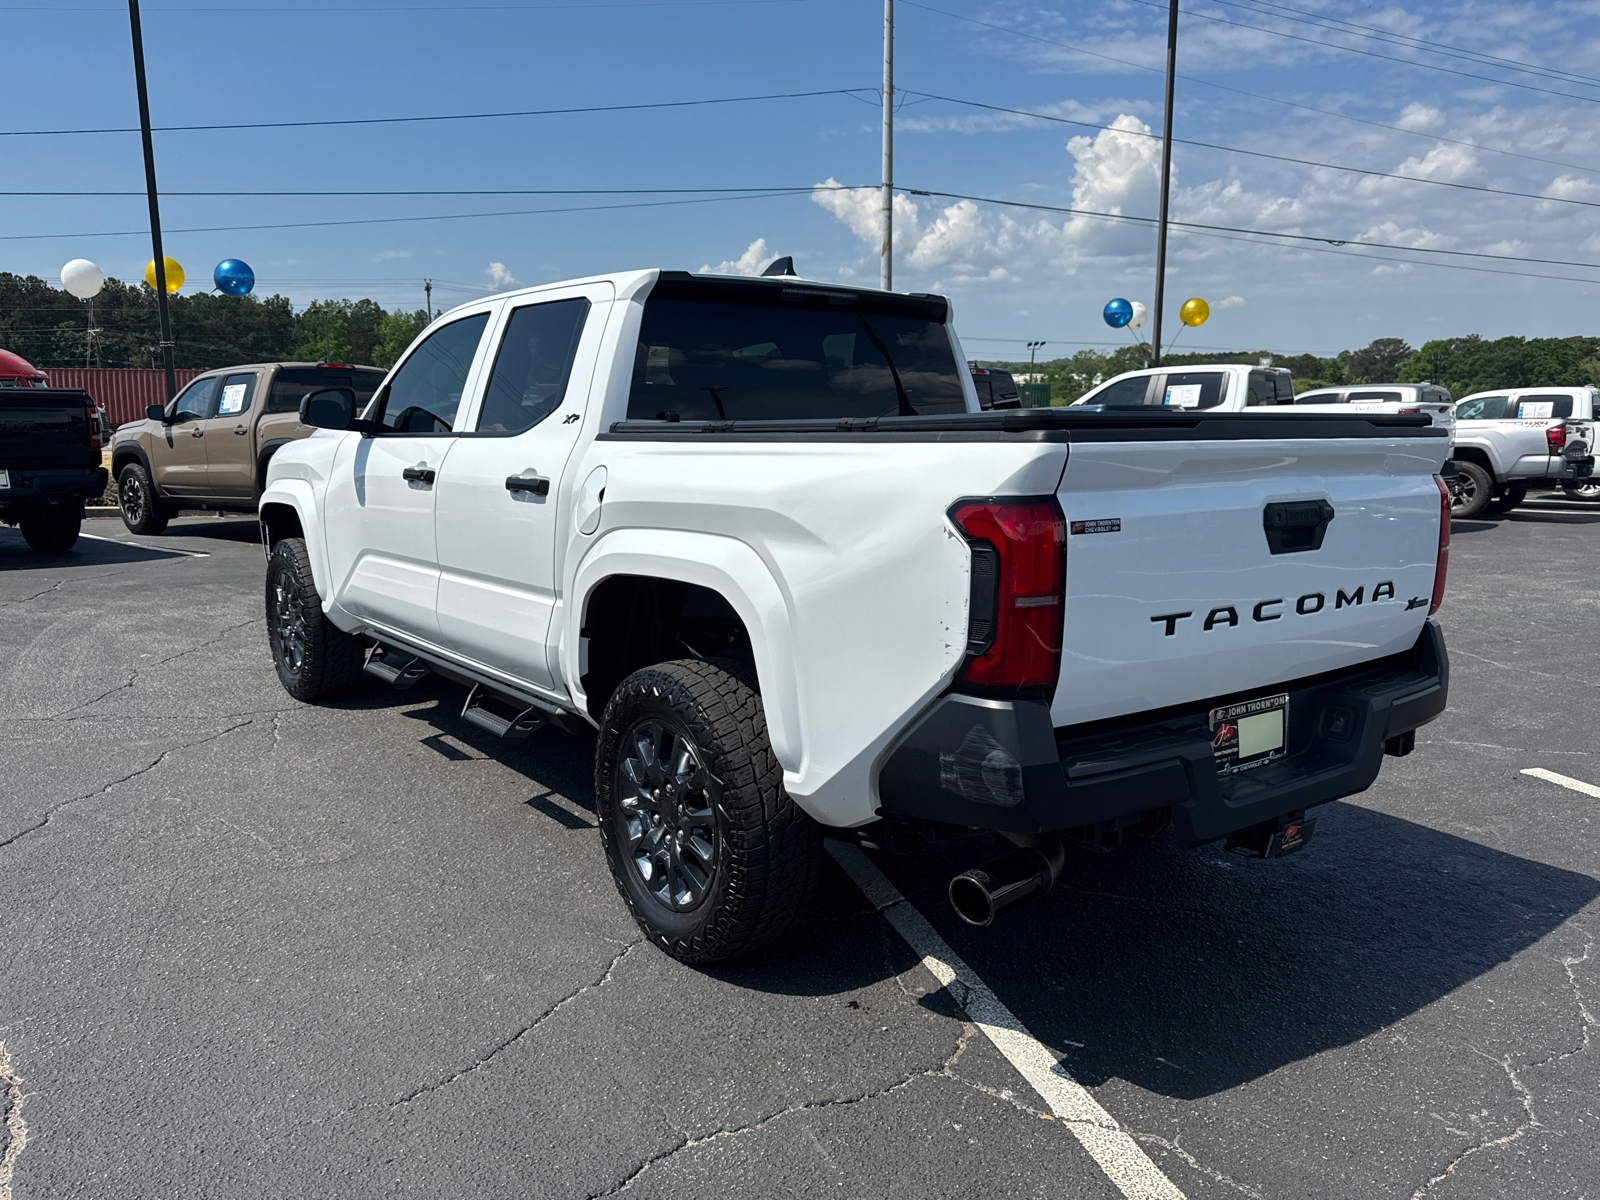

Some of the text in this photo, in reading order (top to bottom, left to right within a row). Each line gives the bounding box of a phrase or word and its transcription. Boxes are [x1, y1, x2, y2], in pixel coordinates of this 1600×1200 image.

[1288, 510, 1319, 521] TOYOTA
[1149, 579, 1396, 637] TACOMA
[1228, 705, 1246, 715] JOHN
[1240, 761, 1262, 771] CHEVROLET
